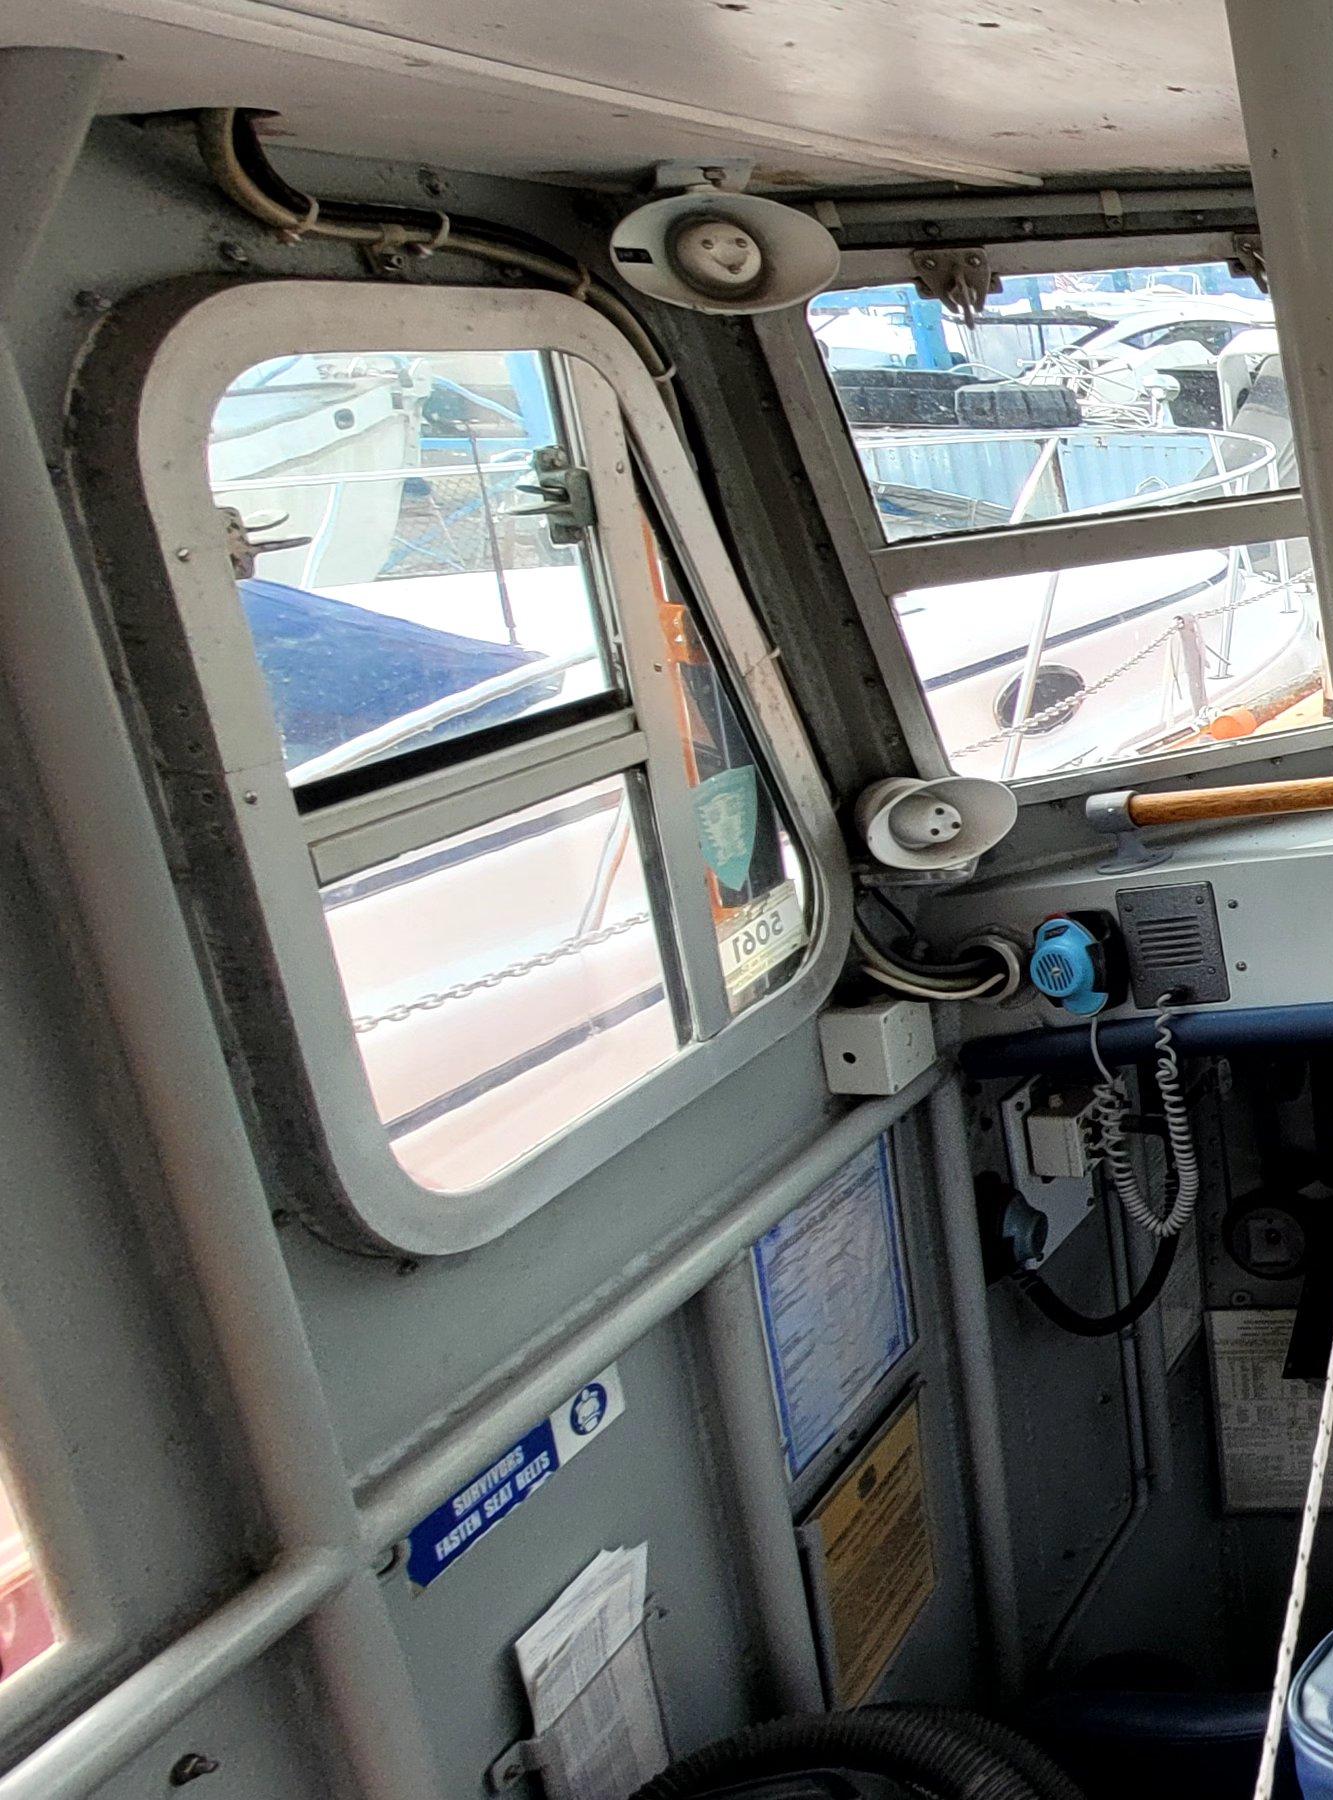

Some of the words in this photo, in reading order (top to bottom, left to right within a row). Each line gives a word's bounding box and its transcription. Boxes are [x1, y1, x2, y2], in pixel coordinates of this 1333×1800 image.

[434, 1509, 483, 1562] FASTEN
[483, 1480, 514, 1519] SEAT
[514, 1450, 551, 1491] BELTS
[452, 1444, 525, 1518] SURVIVORS
